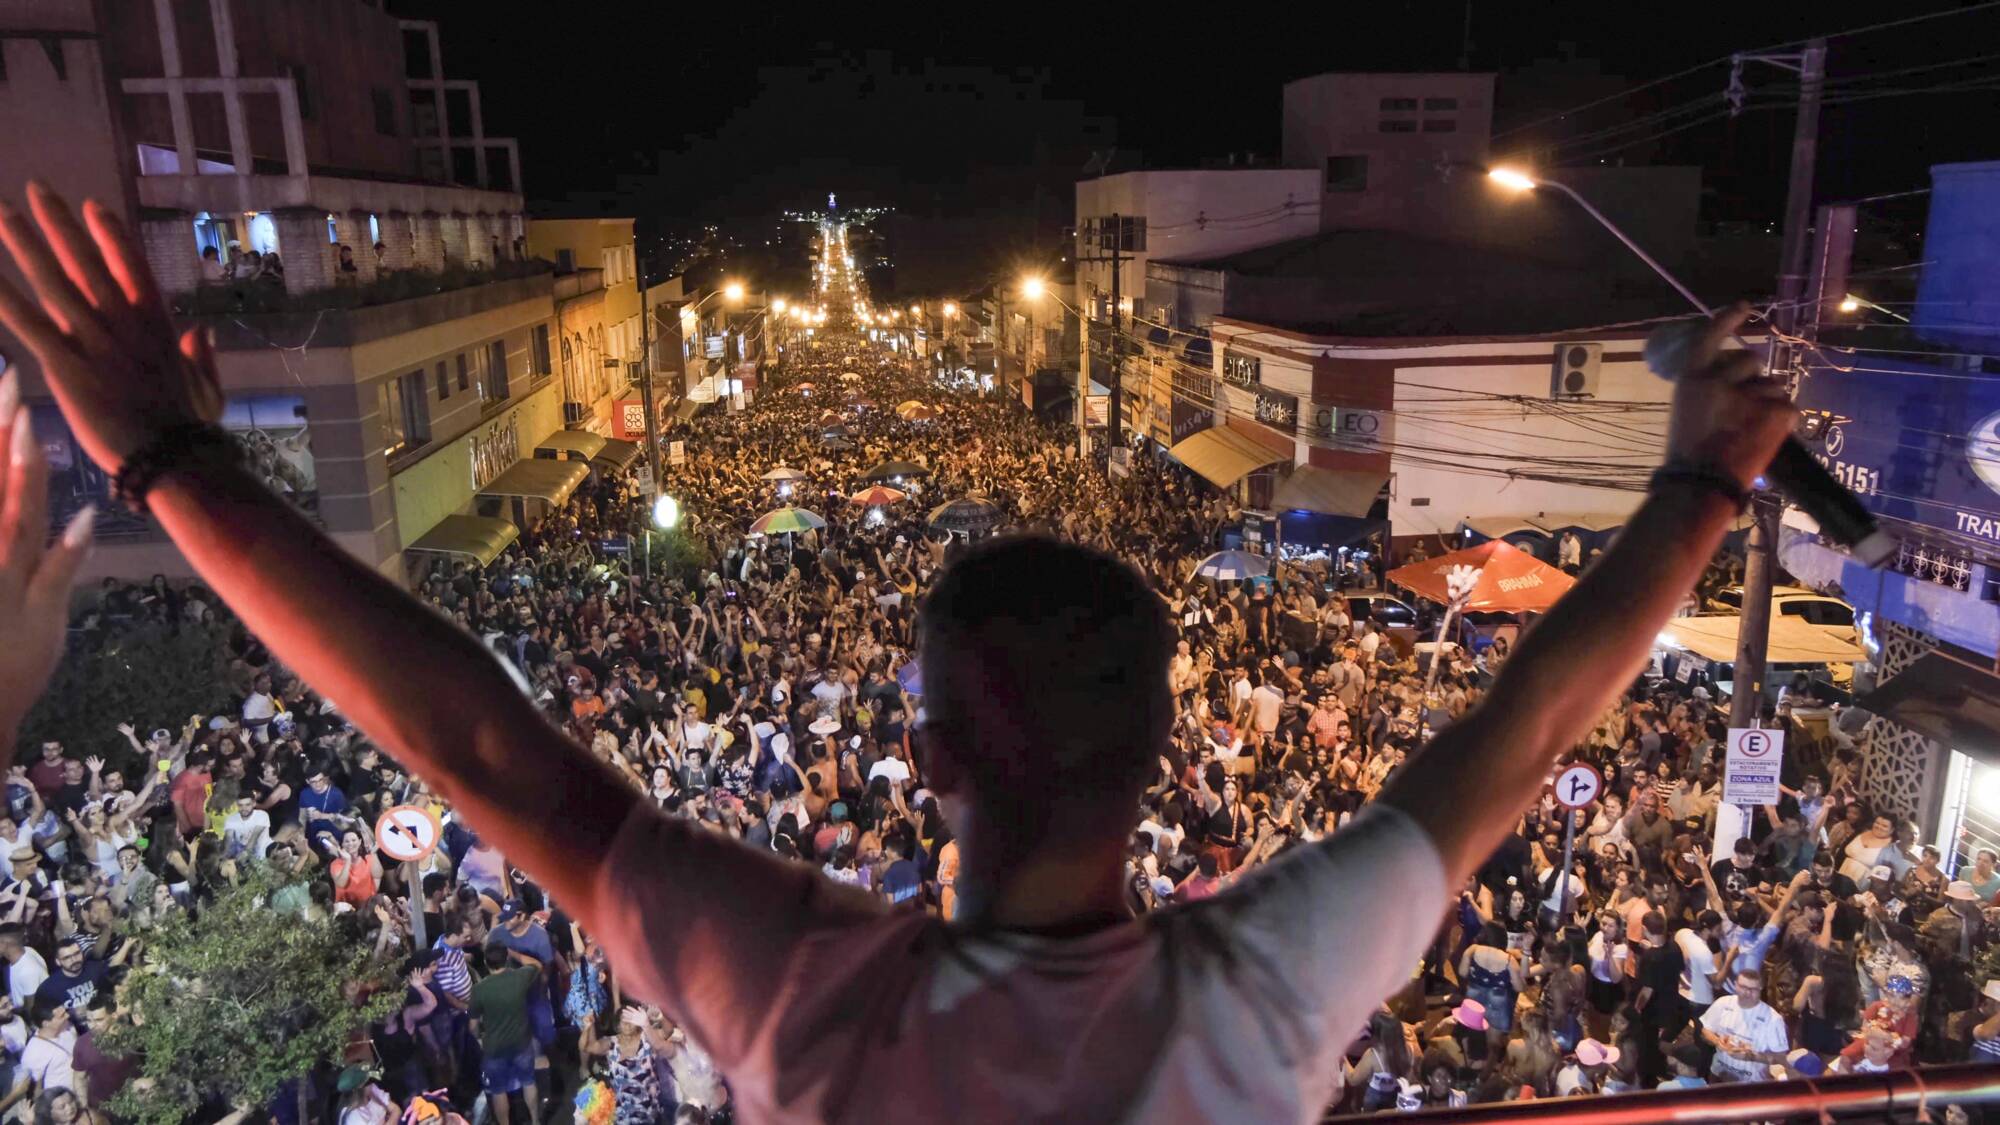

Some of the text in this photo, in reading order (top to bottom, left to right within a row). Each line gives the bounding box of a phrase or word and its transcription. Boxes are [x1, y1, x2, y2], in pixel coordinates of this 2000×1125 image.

[1497, 573, 1544, 593] BRAHMA
[1748, 736, 1761, 752] E
[1752, 775, 1773, 783] AZUL
[66, 980, 95, 999] YOU
